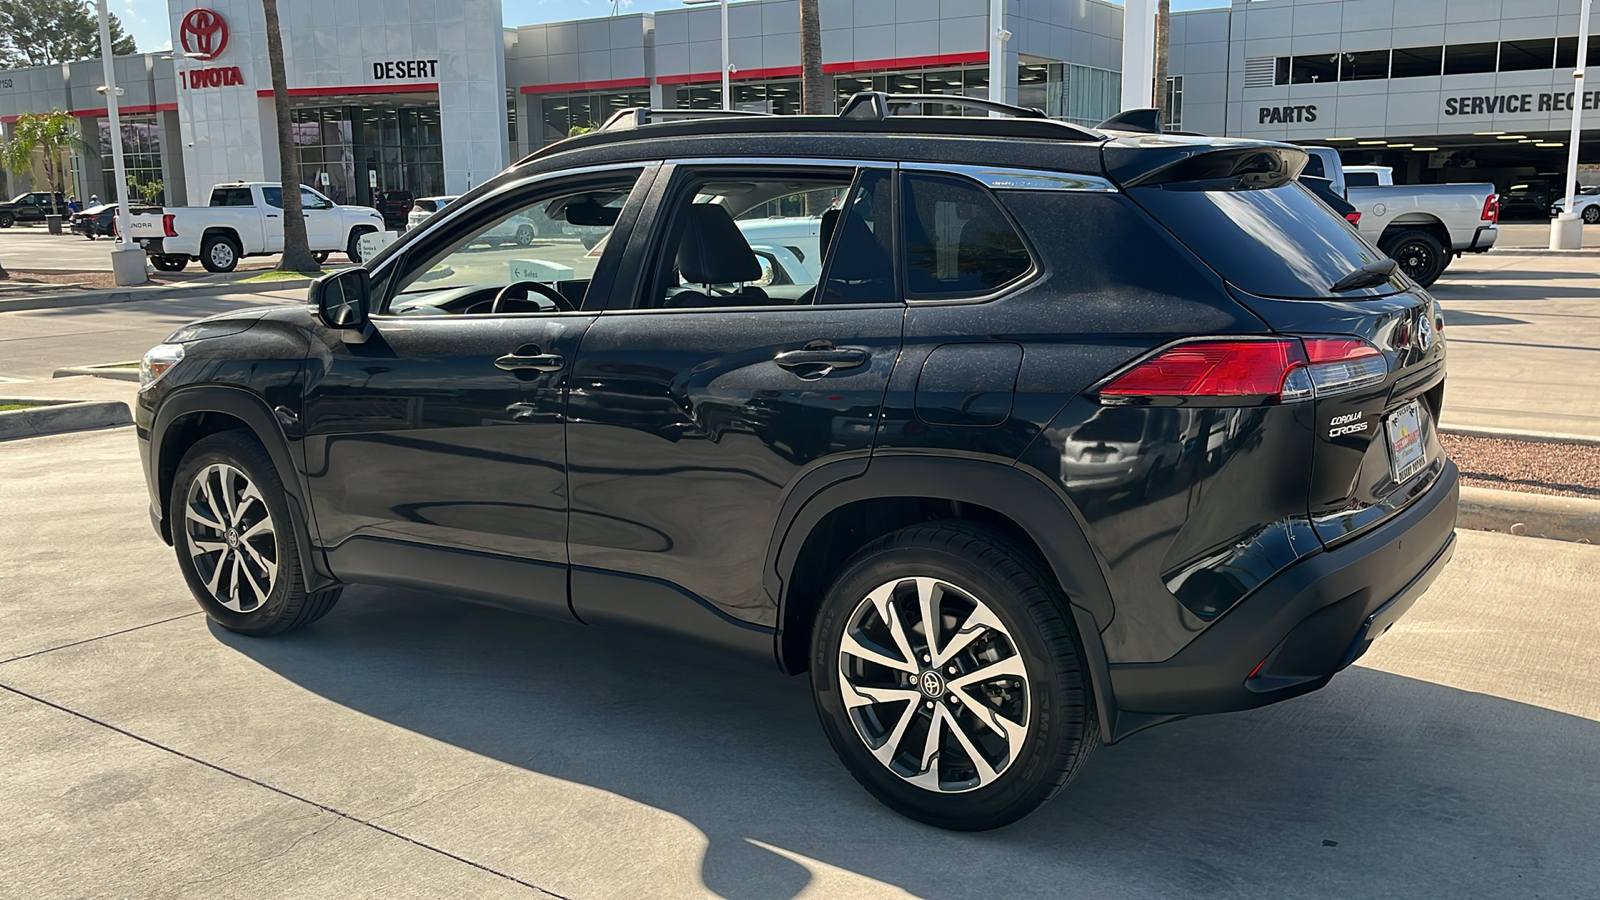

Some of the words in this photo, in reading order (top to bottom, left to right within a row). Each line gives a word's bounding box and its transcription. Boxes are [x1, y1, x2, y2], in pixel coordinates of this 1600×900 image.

[373, 60, 438, 79] DESERT
[1444, 94, 1533, 116] SERVICE
[1259, 105, 1317, 124] PARTS
[523, 269, 538, 278] Sales
[1330, 411, 1362, 425] COROLLA
[1329, 421, 1368, 437] CROSS
